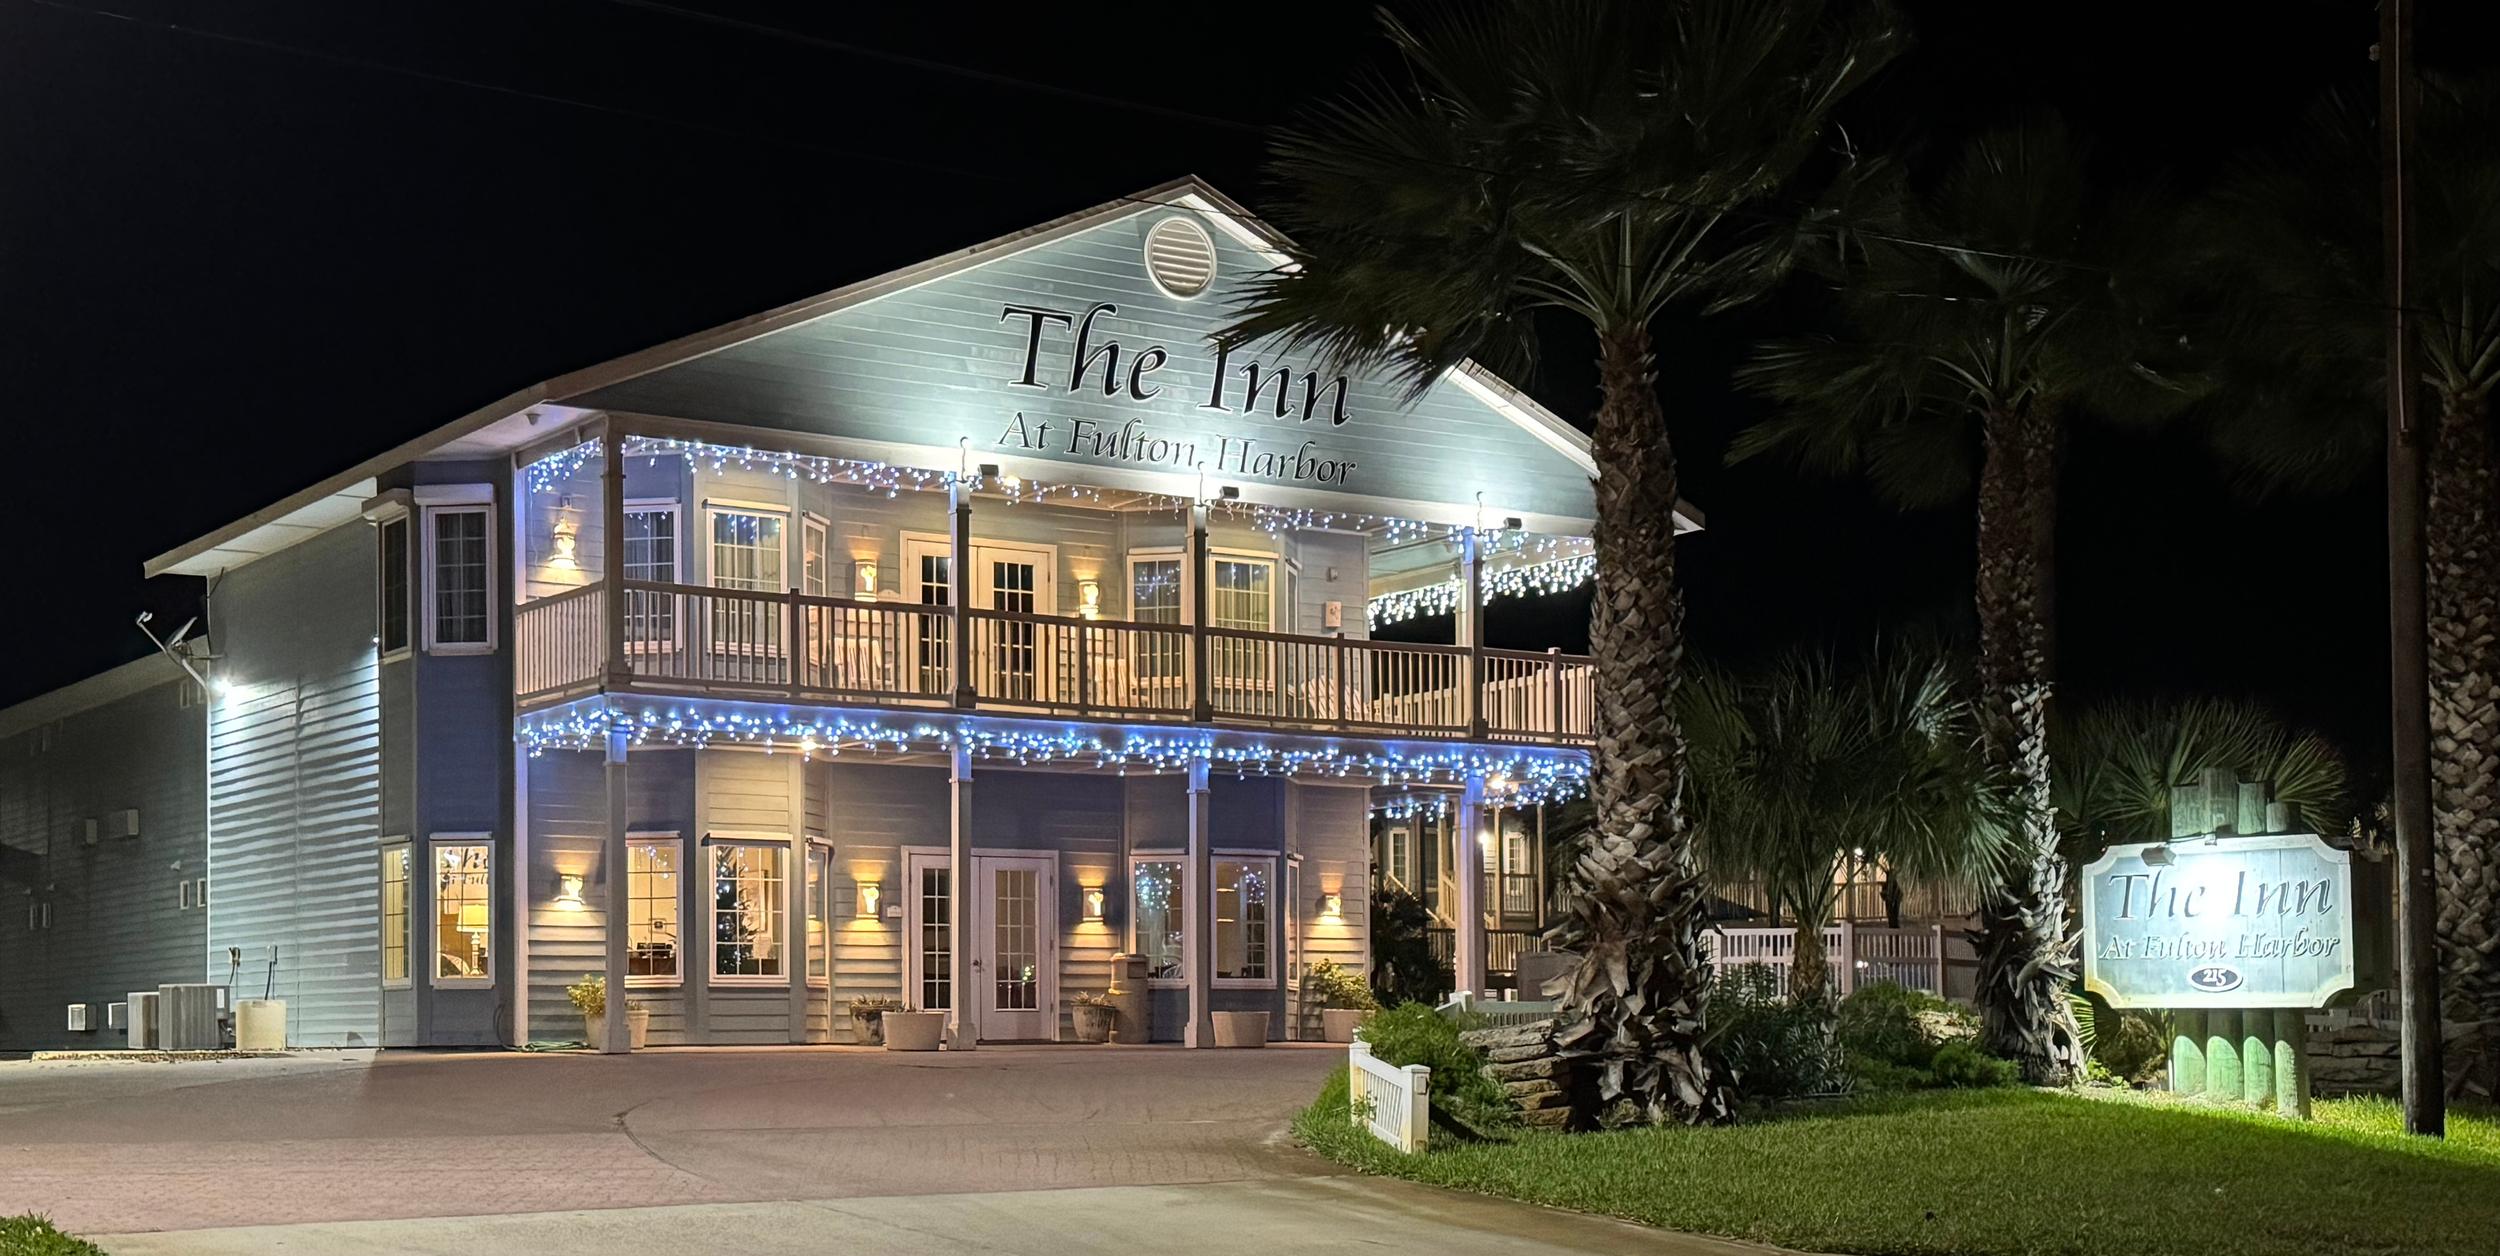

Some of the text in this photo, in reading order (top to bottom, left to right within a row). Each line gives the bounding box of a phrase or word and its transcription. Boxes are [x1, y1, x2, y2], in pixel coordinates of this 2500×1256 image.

[999, 302, 1351, 427] The Inn
[997, 411, 1358, 486] At Fulton Harbor
[2108, 866, 2333, 920] The Inn
[2100, 927, 2340, 960] At Fulton Harbor
[2203, 969, 2227, 987] 215
